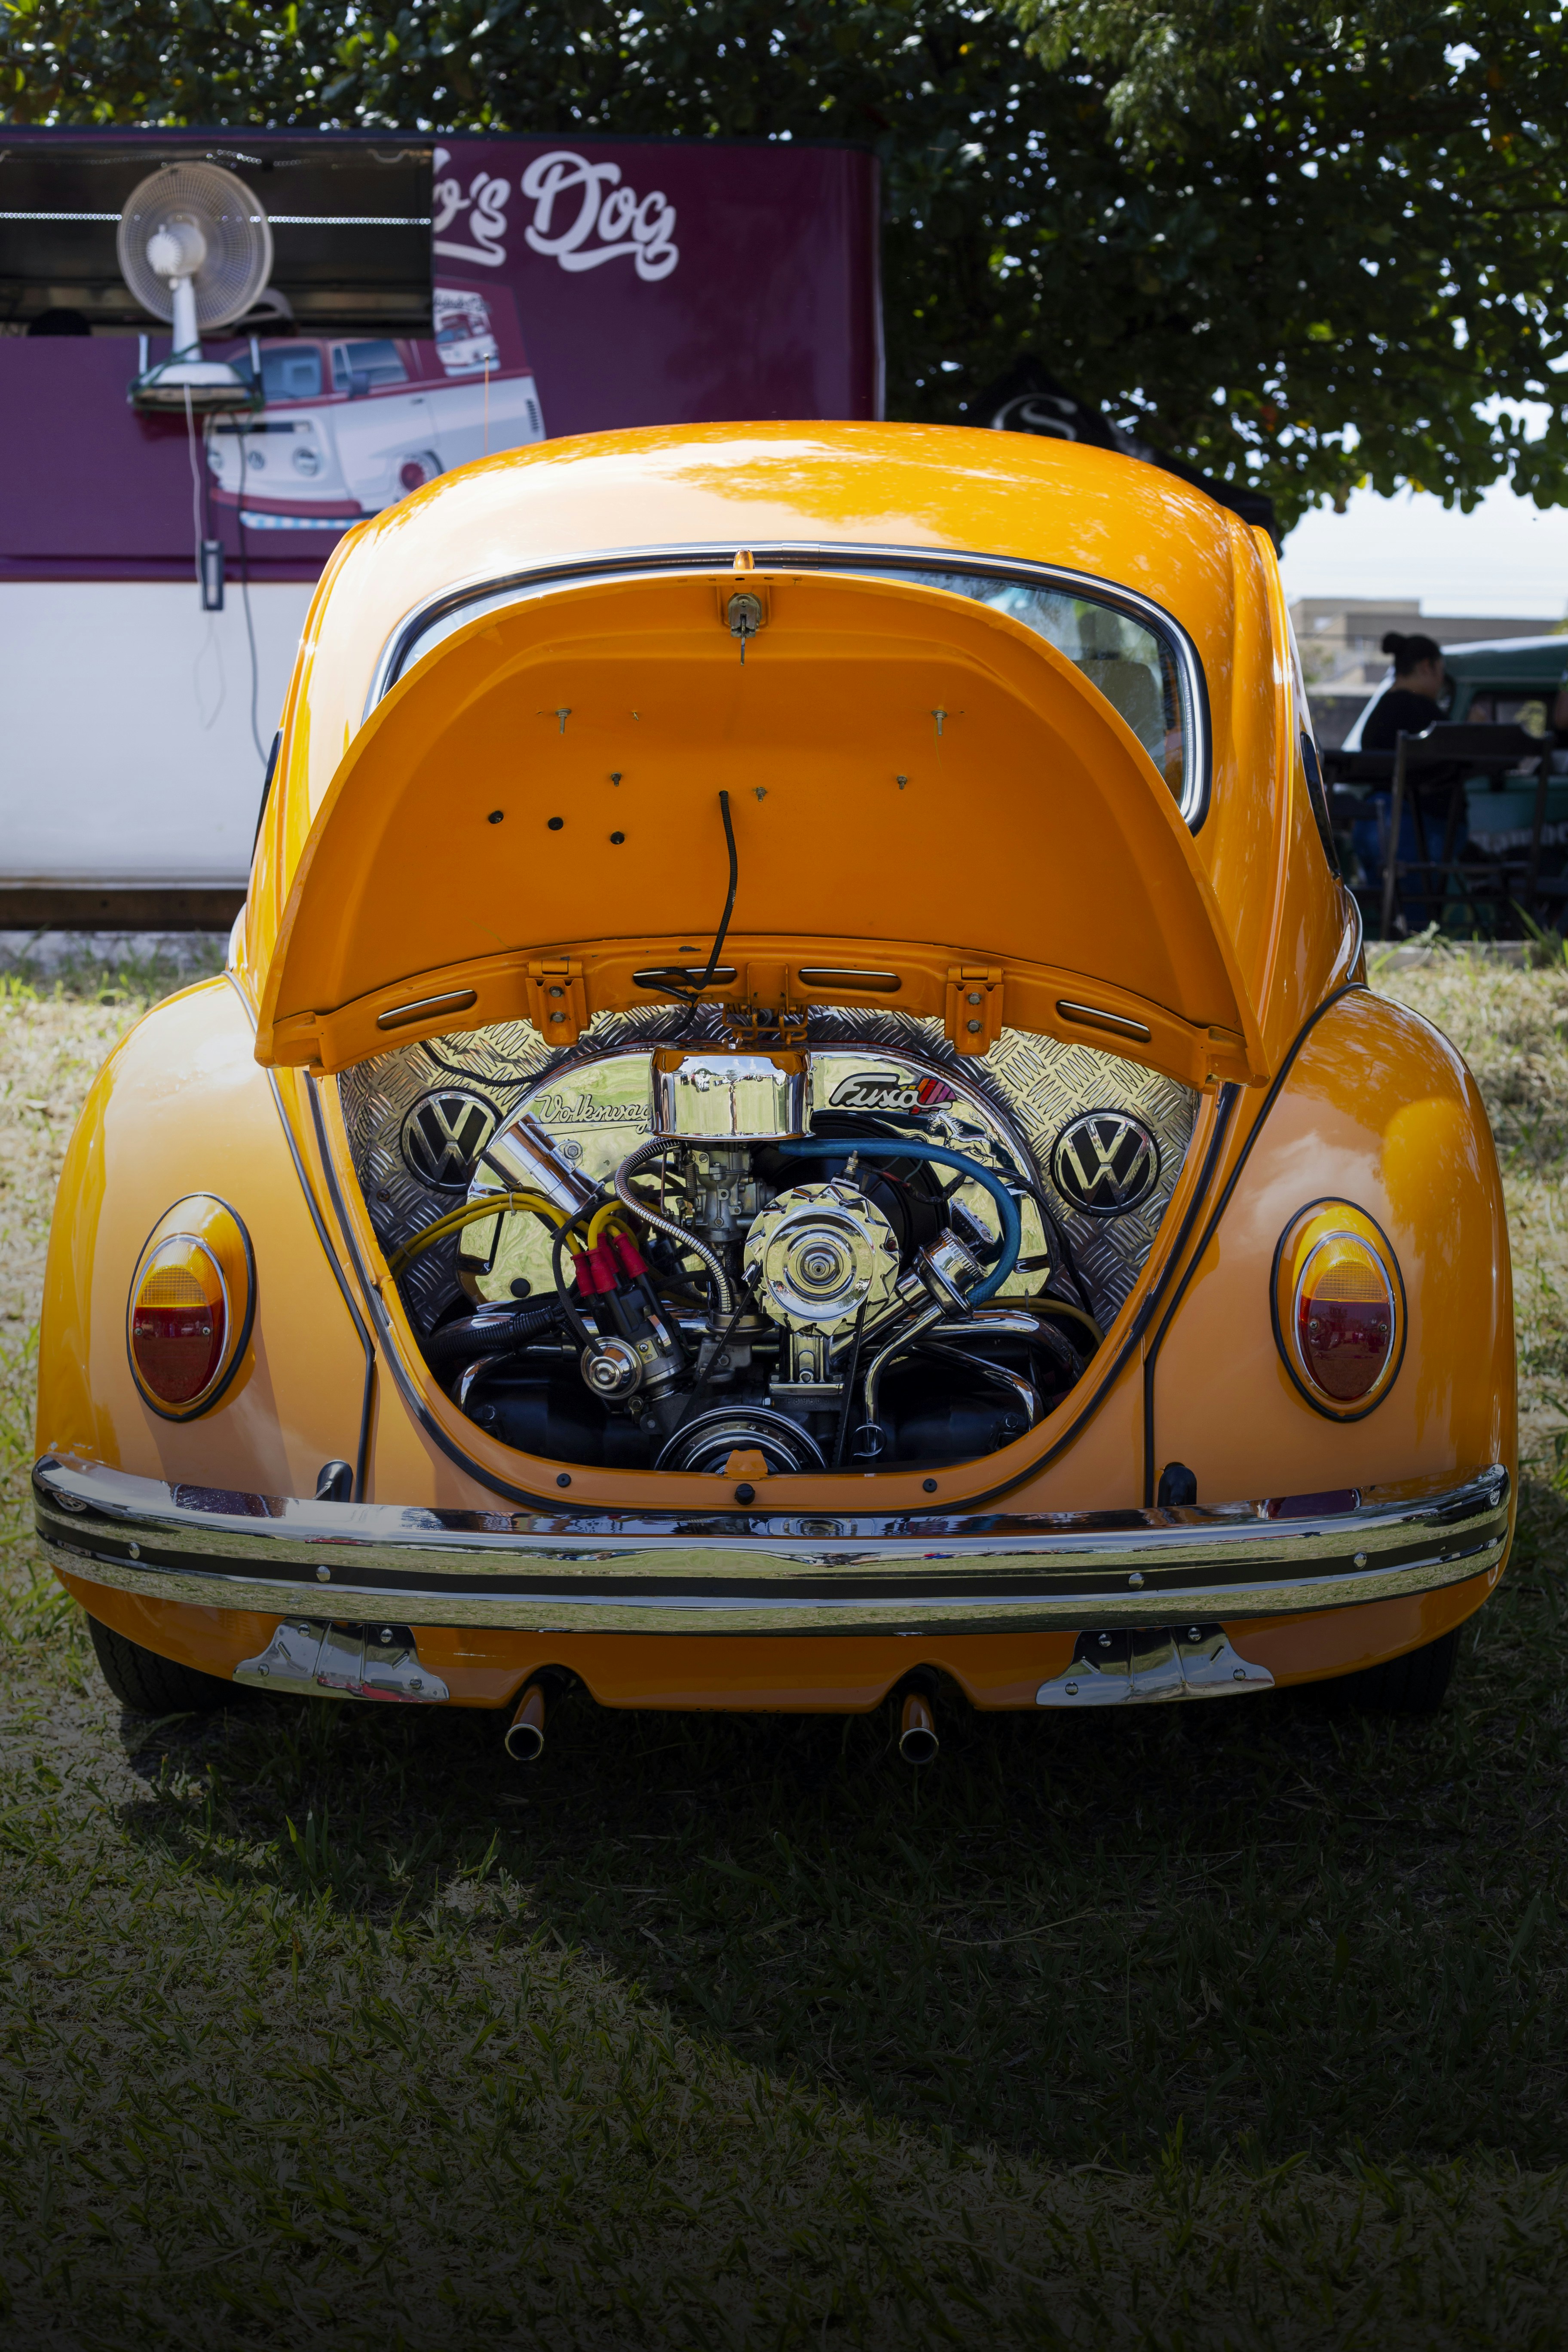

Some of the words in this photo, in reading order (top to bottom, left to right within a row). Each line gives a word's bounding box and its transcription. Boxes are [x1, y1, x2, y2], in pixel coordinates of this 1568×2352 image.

[521, 150, 679, 281] Dog
[831, 1075, 952, 1109] Fusca
[1056, 1111, 1157, 1212] VW
